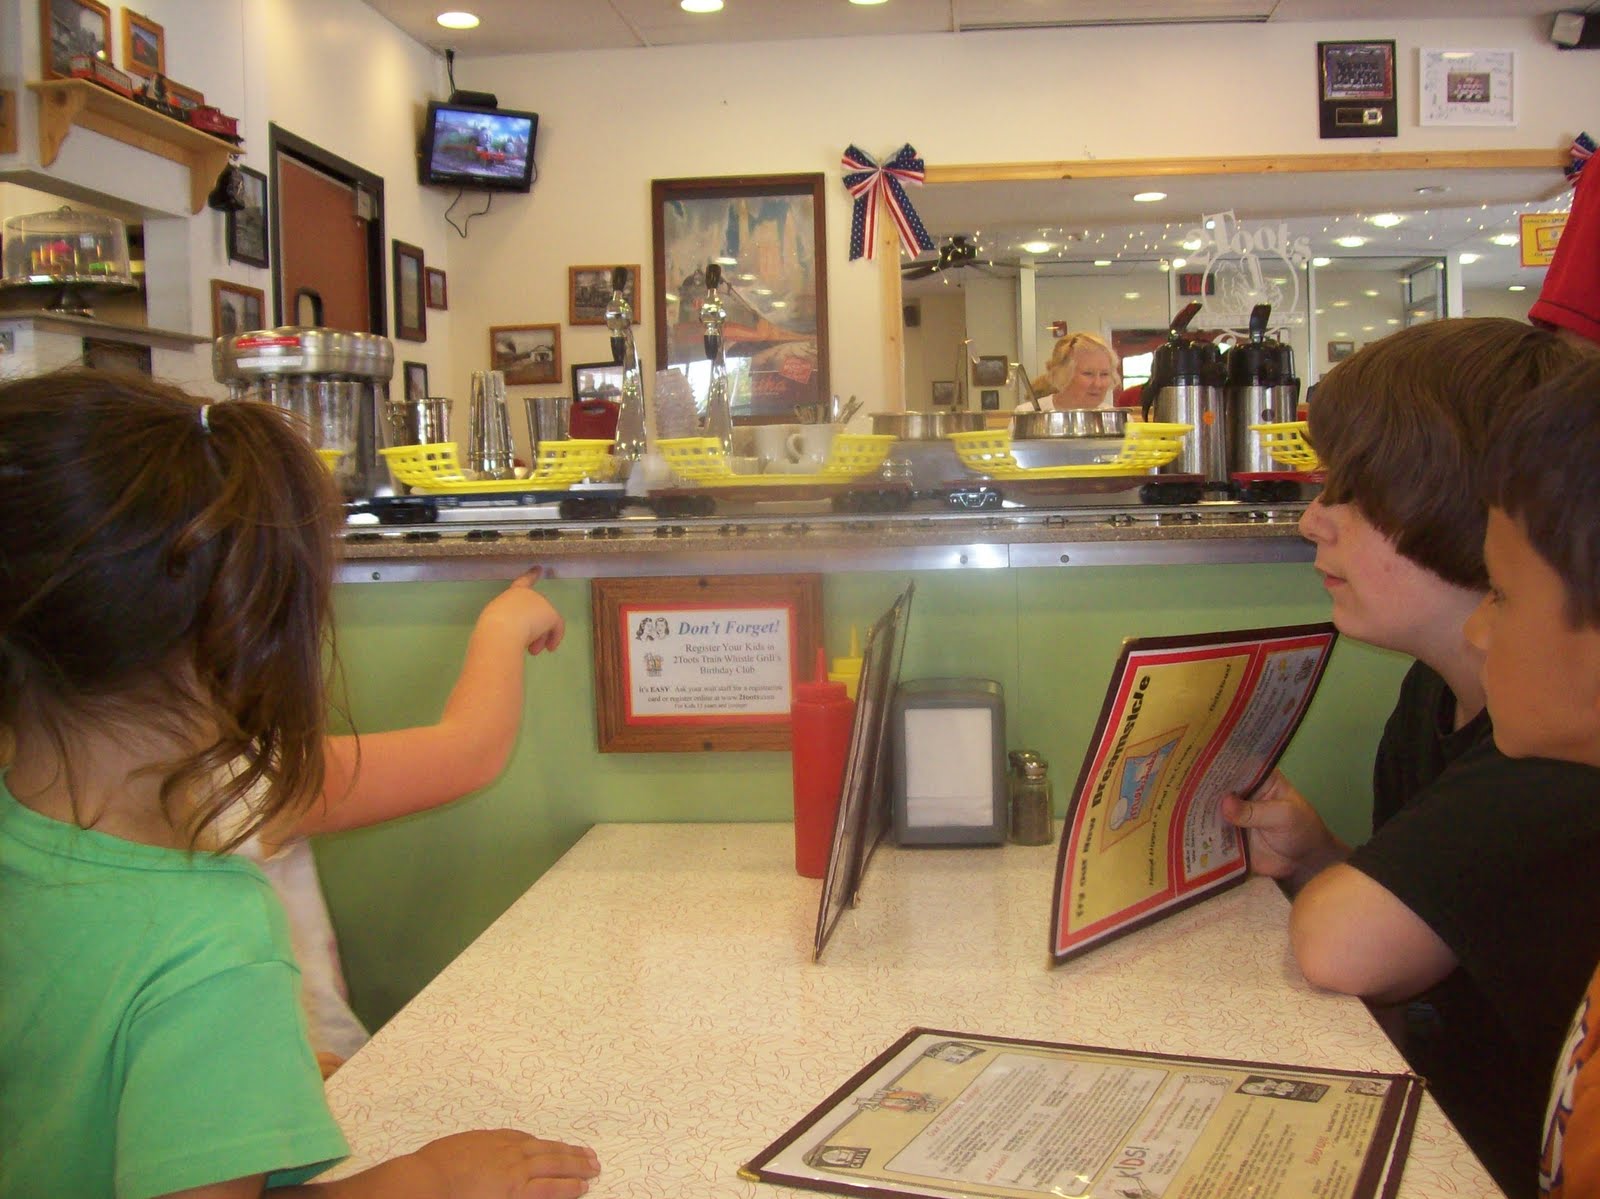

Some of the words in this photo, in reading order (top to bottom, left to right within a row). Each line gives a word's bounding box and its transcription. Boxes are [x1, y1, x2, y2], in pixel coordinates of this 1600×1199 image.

[678, 621, 720, 635] Don't
[725, 619, 780, 637] Forget!
[685, 643, 720, 654] Register
[722, 643, 742, 652] Your
[745, 642, 765, 651] Kids
[673, 655, 700, 664] 2Toots
[702, 655, 722, 663] Train
[724, 654, 754, 663] Whistle
[700, 665, 733, 675] Birthday
[736, 665, 755, 674] Club
[1113, 1146, 1150, 1179] KIDS!
